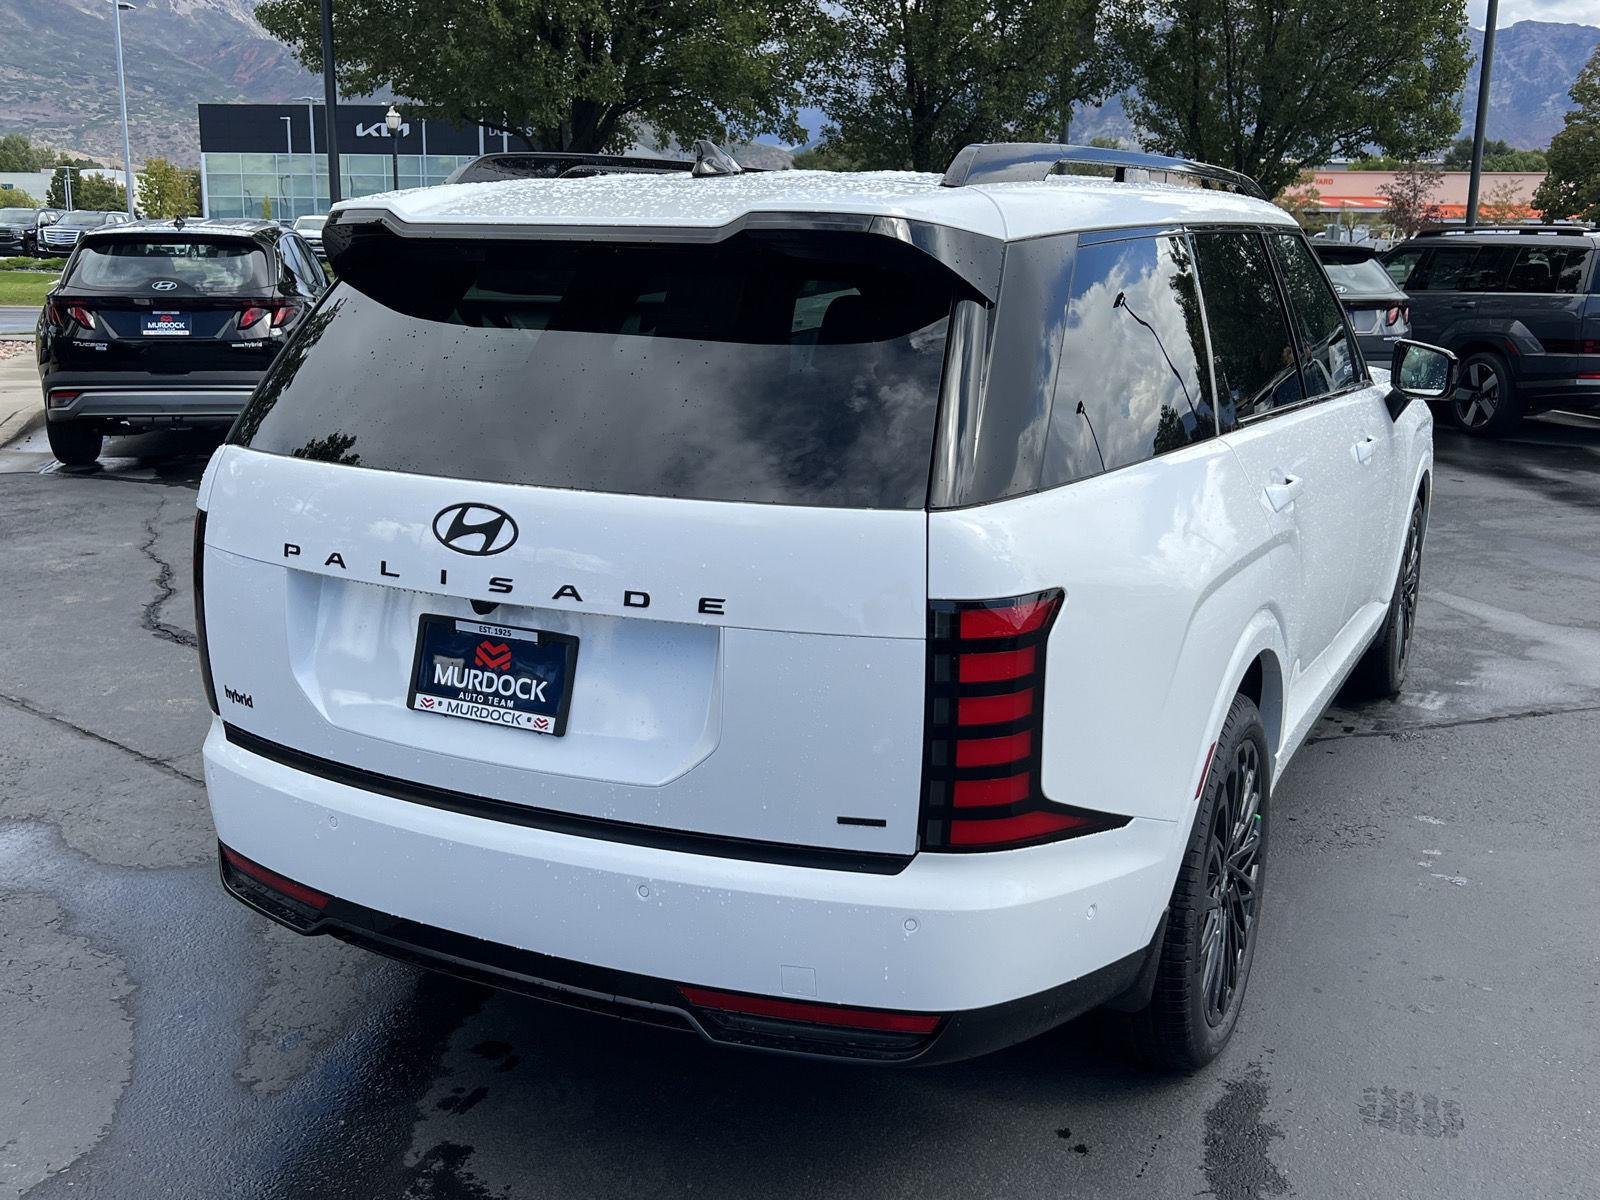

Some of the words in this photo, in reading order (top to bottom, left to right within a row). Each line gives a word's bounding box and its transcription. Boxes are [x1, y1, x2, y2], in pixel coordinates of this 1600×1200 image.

[283, 542, 727, 616] PALISADE
[478, 625, 493, 635] EST.
[494, 627, 512, 637] 1925
[433, 663, 548, 702] MURDOCK
[224, 684, 254, 708] hybrid
[458, 691, 484, 703] AUTO
[488, 696, 514, 708] TEAM
[446, 701, 523, 726] MURDOCK
